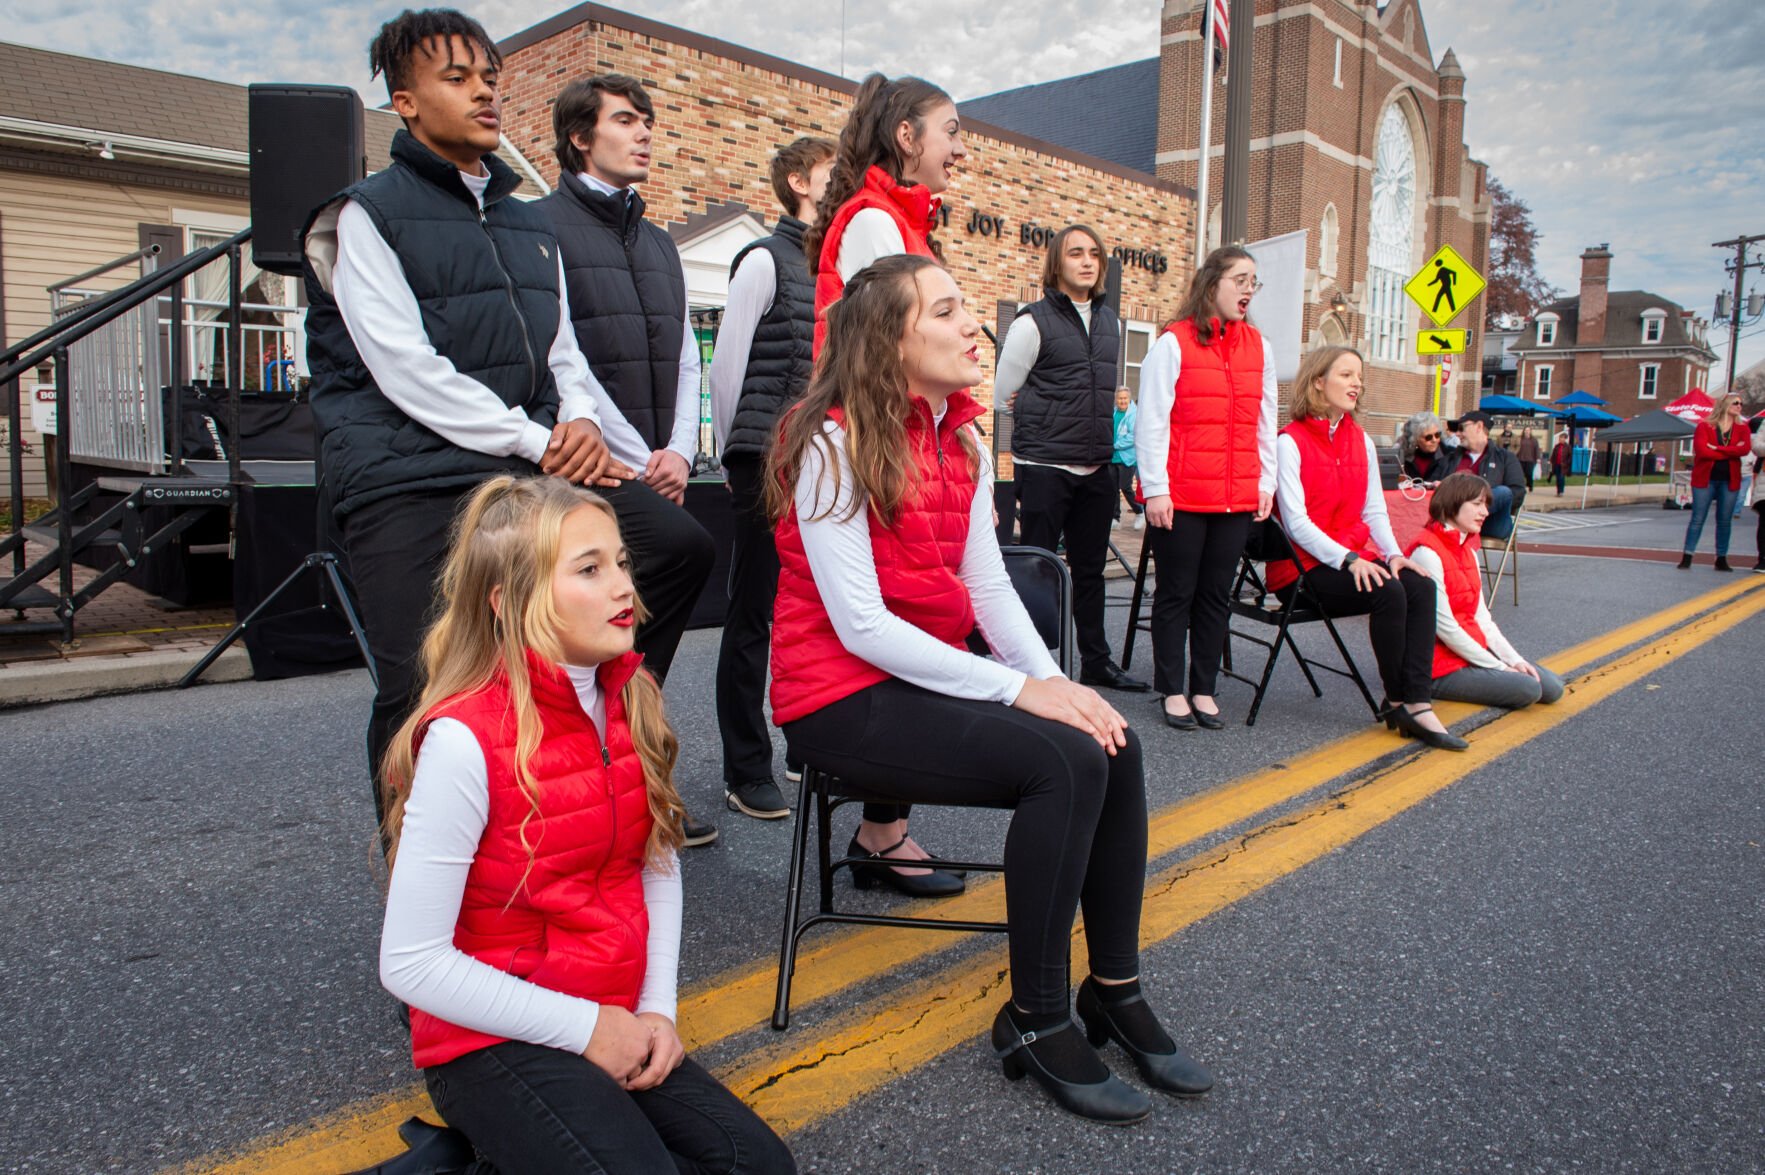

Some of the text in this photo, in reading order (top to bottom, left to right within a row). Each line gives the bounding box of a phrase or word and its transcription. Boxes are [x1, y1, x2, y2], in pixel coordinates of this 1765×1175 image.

[966, 209, 1005, 239] JOY
[1112, 245, 1168, 273] OFFICES
[166, 488, 211, 497] GUARDIAN
